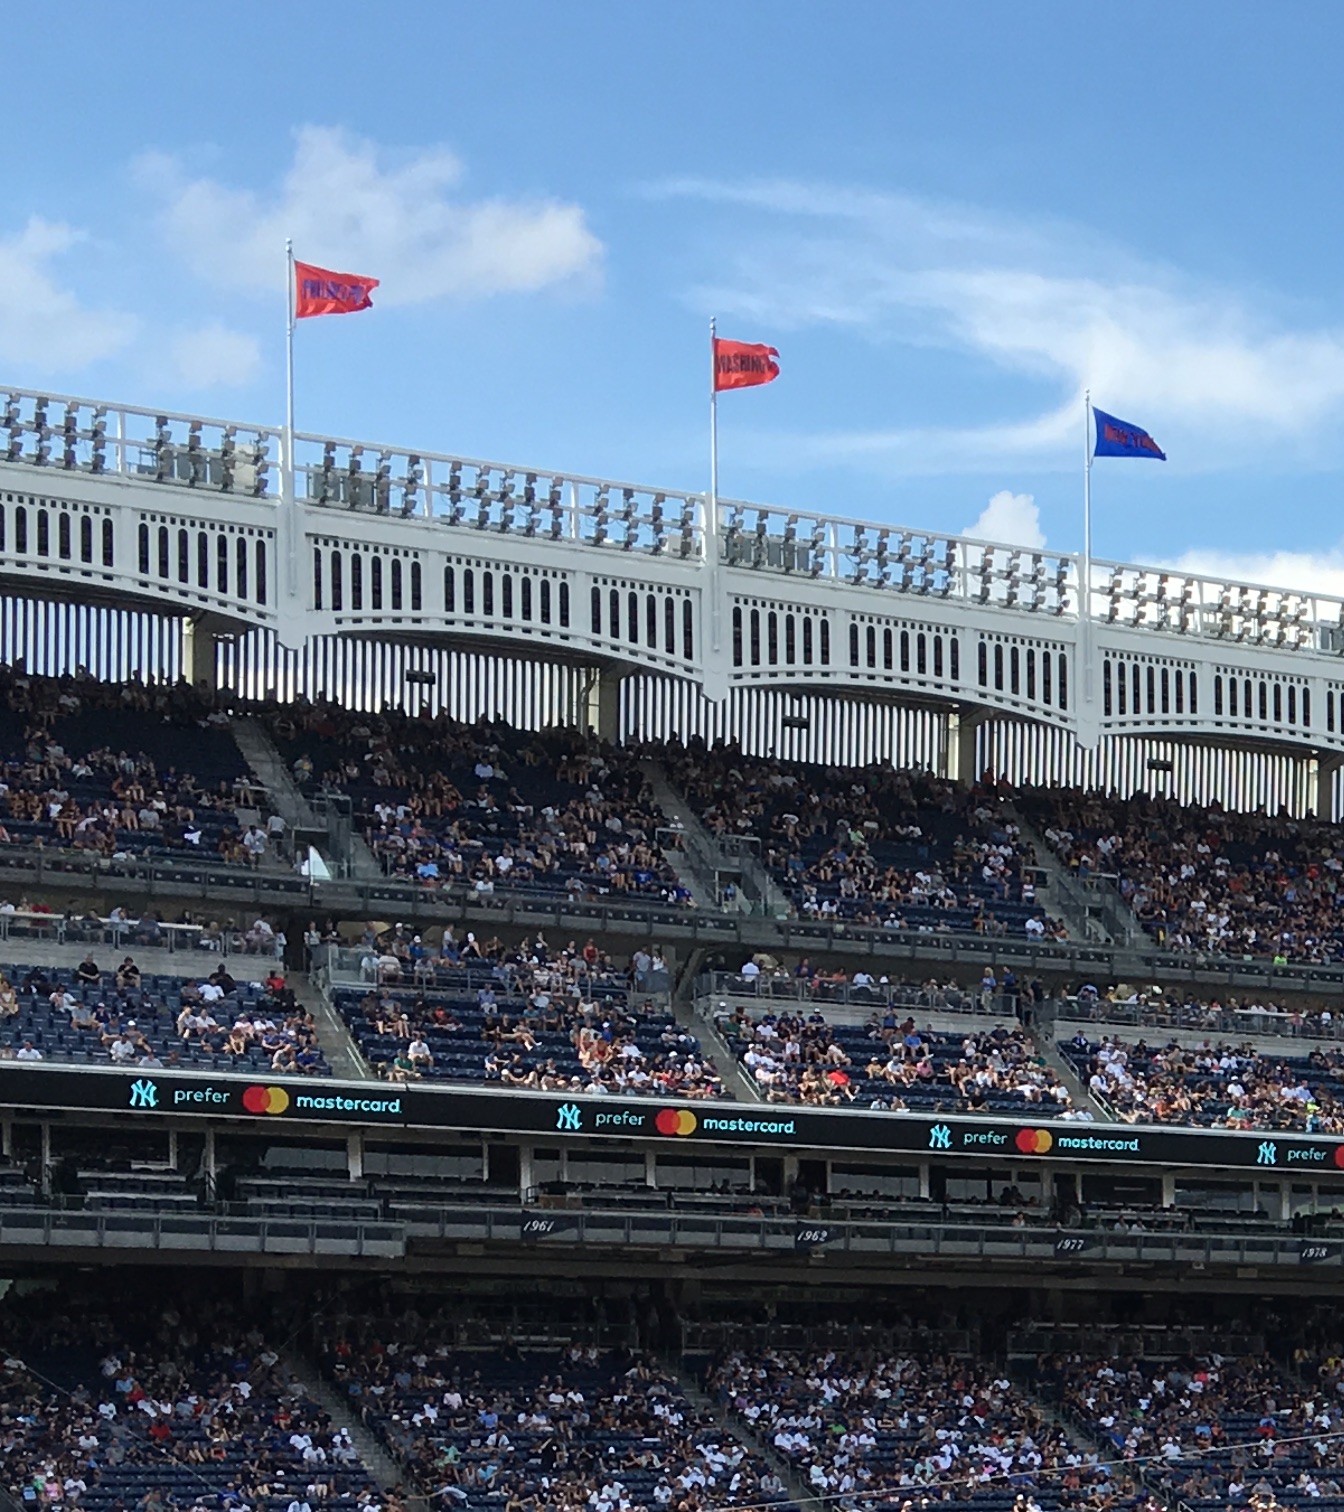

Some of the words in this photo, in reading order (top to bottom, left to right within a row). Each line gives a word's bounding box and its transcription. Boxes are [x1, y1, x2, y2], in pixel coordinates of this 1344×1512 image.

[174, 1088, 230, 1107] prefer
[297, 1095, 402, 1112] mastercard
[595, 1112, 645, 1126] prefer
[703, 1118, 796, 1134] mastercard
[963, 1132, 1008, 1146] prefer
[1058, 1137, 1140, 1151] mastercard
[1287, 1149, 1327, 1162] prefer
[523, 1220, 555, 1232] 1961
[797, 1231, 829, 1242] 1962
[1057, 1239, 1084, 1251] 1977
[1302, 1247, 1328, 1258] 1978
